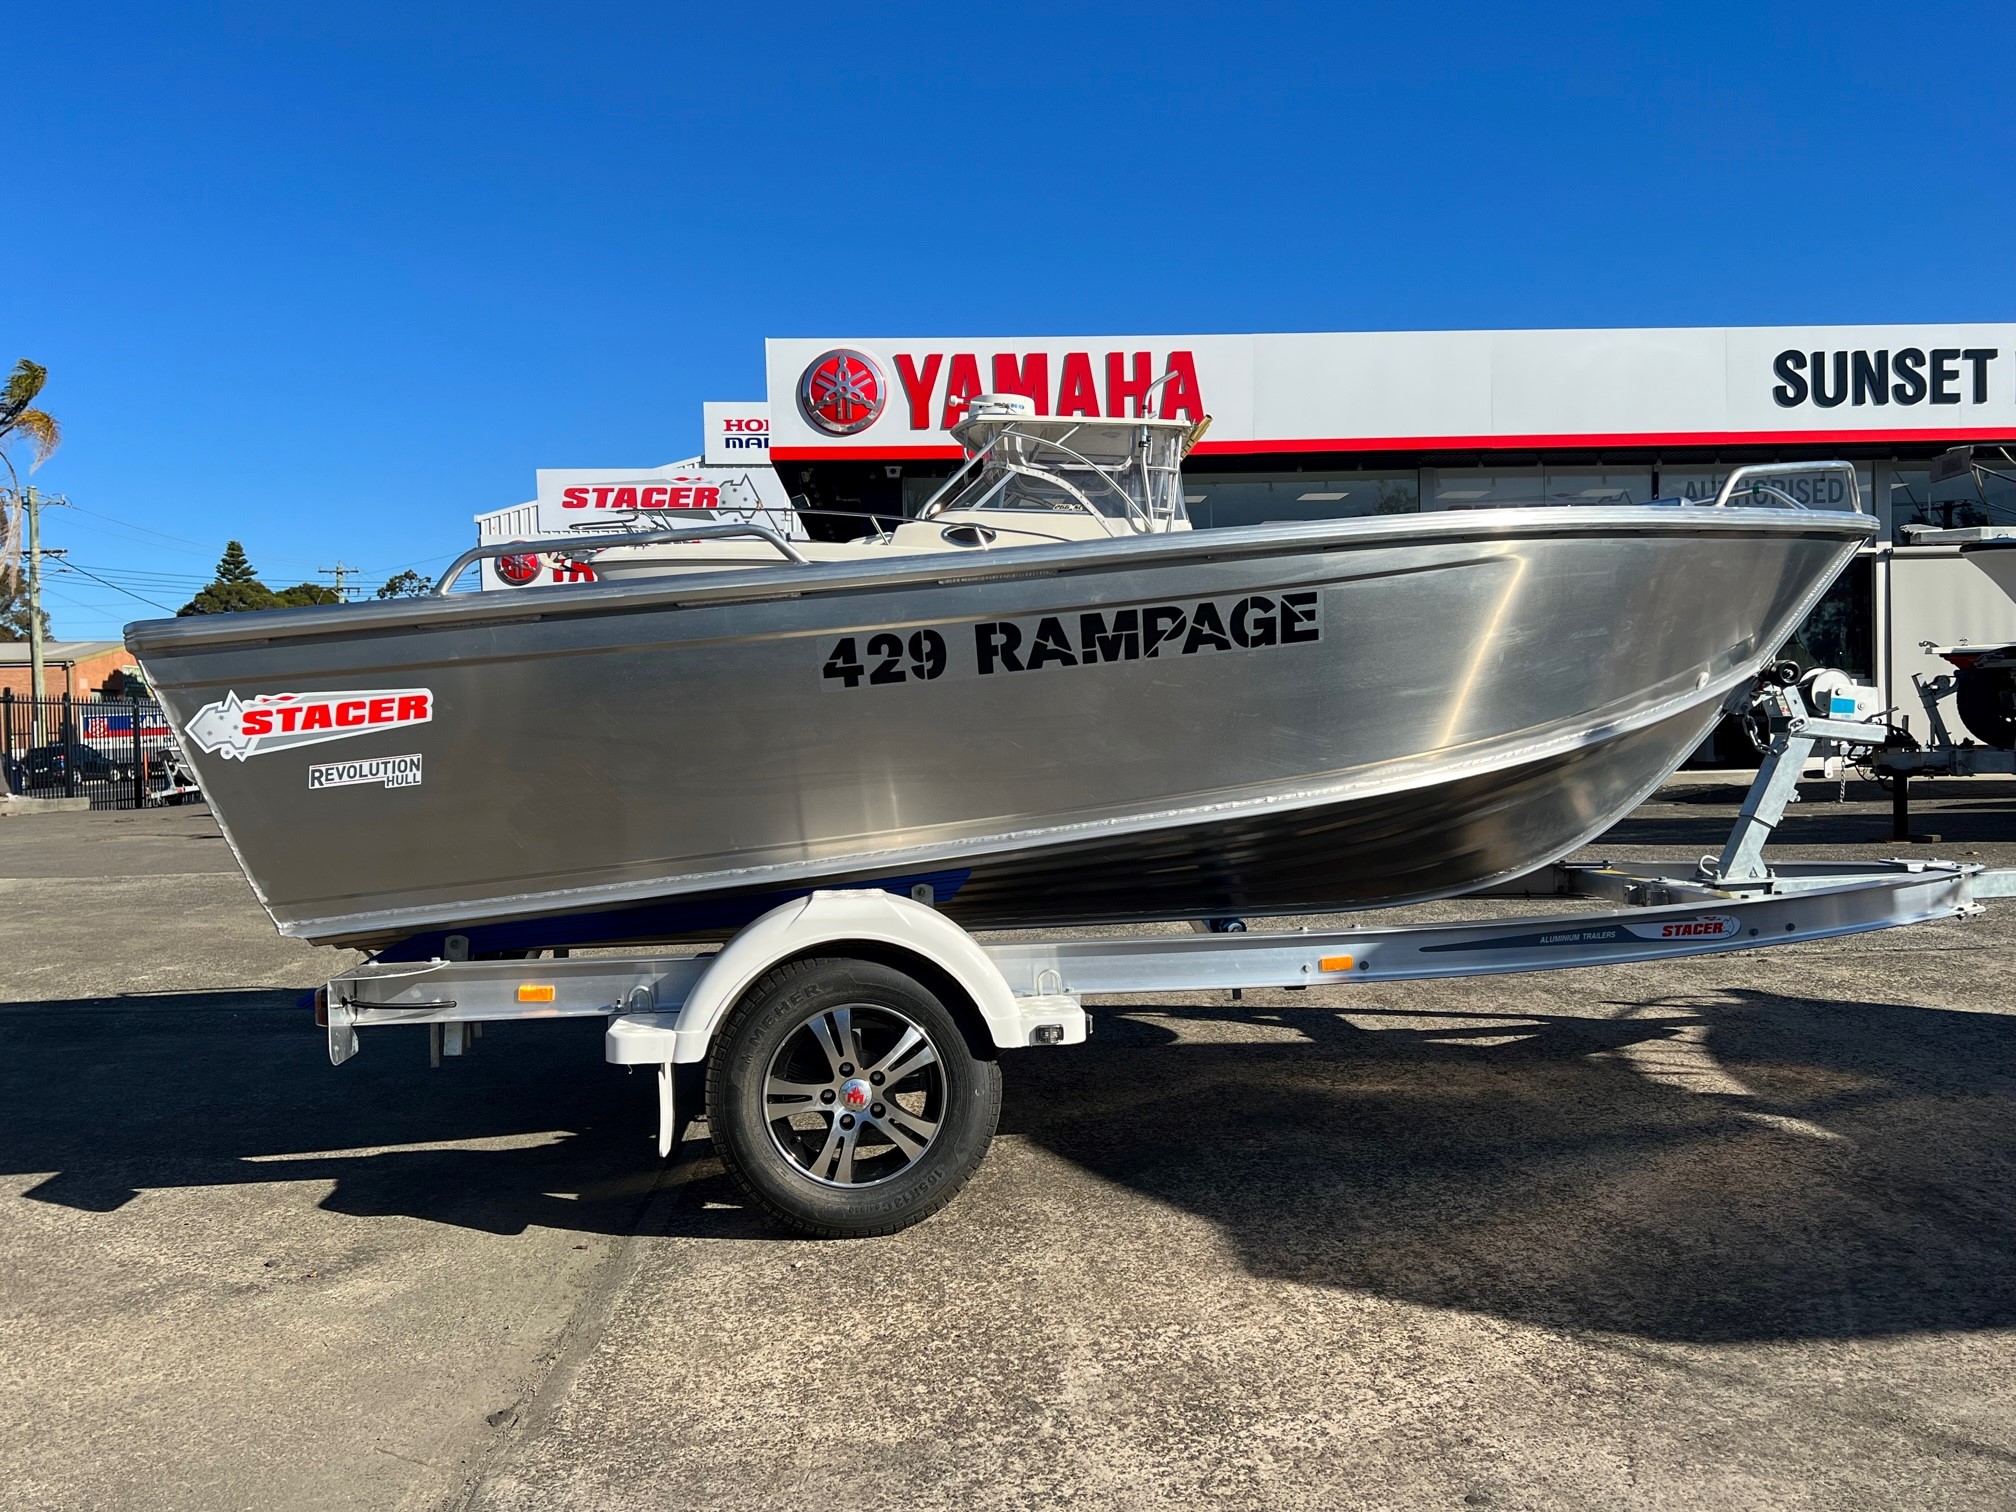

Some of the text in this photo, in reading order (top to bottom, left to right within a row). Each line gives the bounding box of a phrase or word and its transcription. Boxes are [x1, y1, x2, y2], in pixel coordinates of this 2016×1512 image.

[894, 351, 1208, 430] YAMAHA
[1773, 348, 1998, 408] SUNSET
[562, 487, 720, 509] STACER
[822, 591, 1320, 688] 429 RAMPAGE
[241, 694, 428, 736] STACER
[311, 756, 421, 788] REVOLUTION
[385, 773, 421, 787] HULL
[1539, 930, 1616, 944] ALUMINIUM TRAILERS
[1661, 922, 1724, 938] STACER
